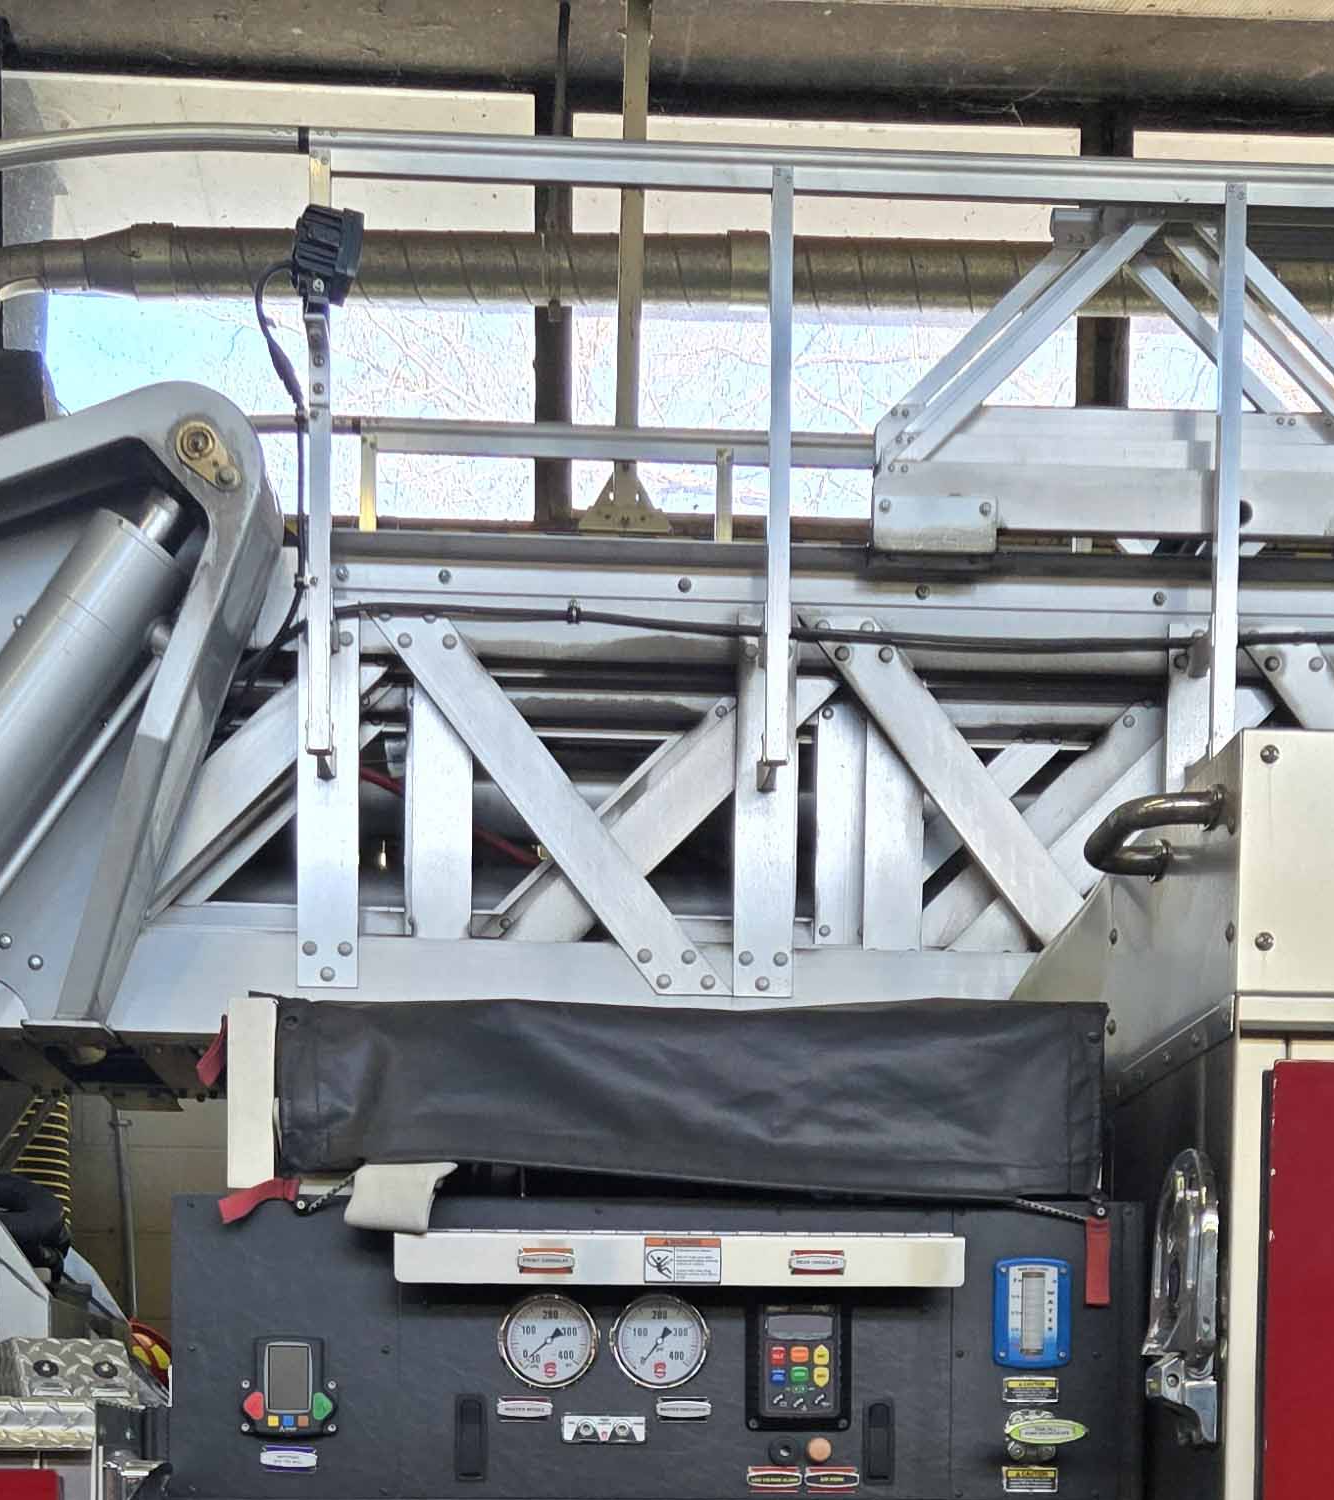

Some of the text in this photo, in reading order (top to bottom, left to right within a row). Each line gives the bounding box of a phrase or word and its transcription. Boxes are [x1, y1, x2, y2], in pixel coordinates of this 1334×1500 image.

[522, 1325, 536, 1335] 100
[633, 1327, 648, 1337] 100
[672, 1327, 688, 1337] 300
[558, 1351, 574, 1360] 400
[669, 1351, 685, 1361] 400
